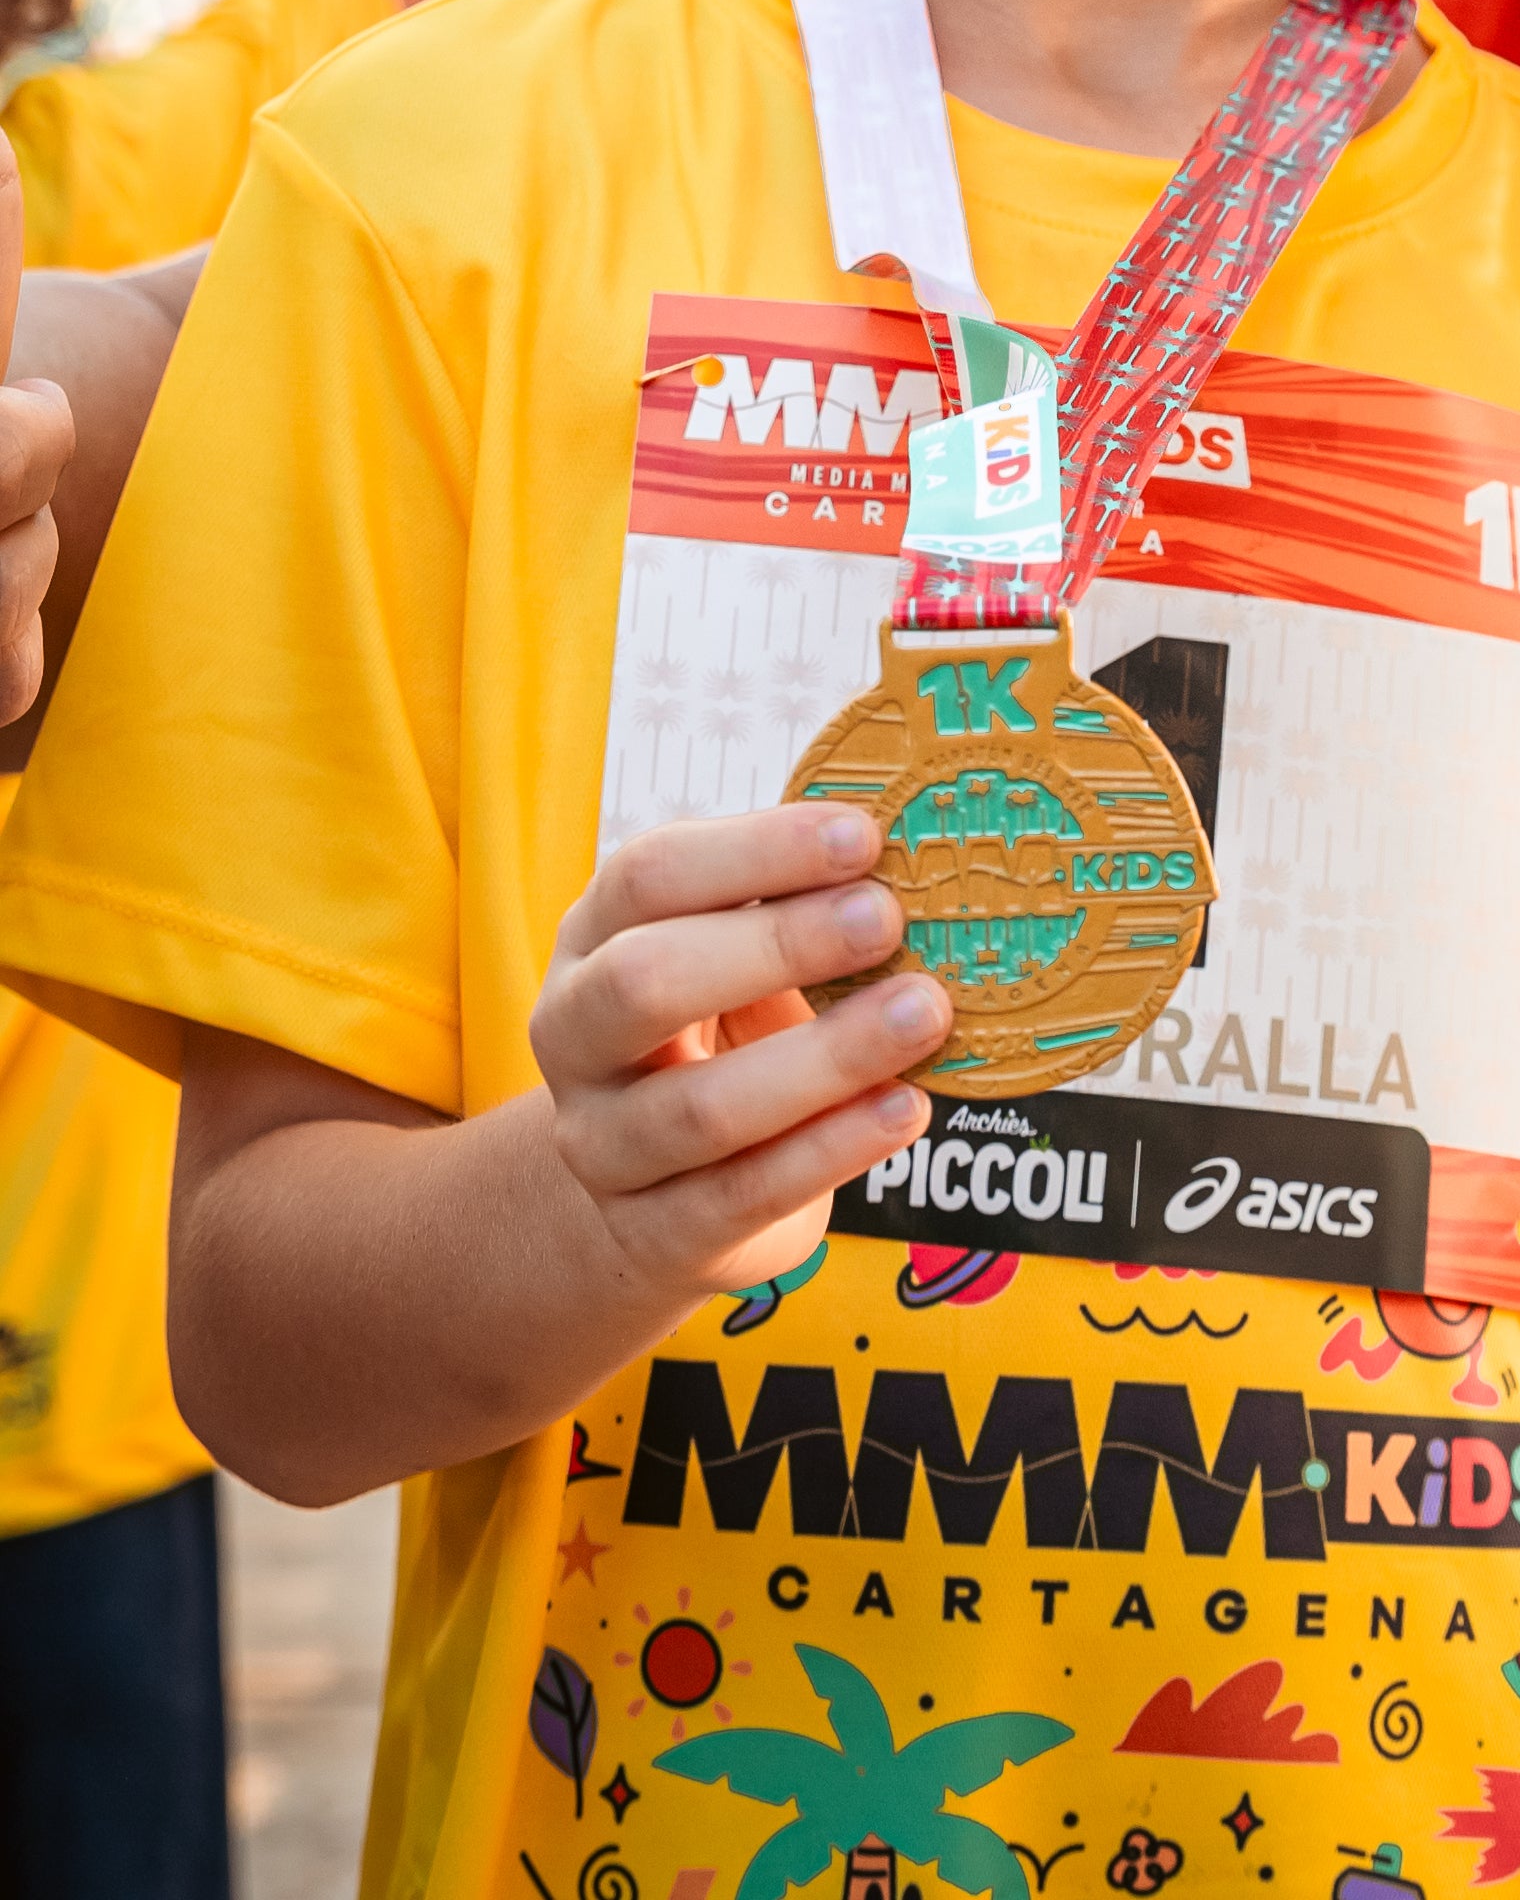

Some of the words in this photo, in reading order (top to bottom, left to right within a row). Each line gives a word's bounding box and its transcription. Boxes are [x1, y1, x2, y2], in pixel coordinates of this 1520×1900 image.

[683, 354, 946, 457] MM
[1160, 423, 1234, 471] DS
[764, 491, 886, 526] CAR
[790, 463, 874, 490] MEDIA
[917, 657, 1037, 737] 1K
[1071, 851, 1197, 893] KiDS
[1236, 1177, 1378, 1238] asics
[622, 1357, 1328, 1561] MMM
[766, 1565, 1476, 1643] CARTAGENA
